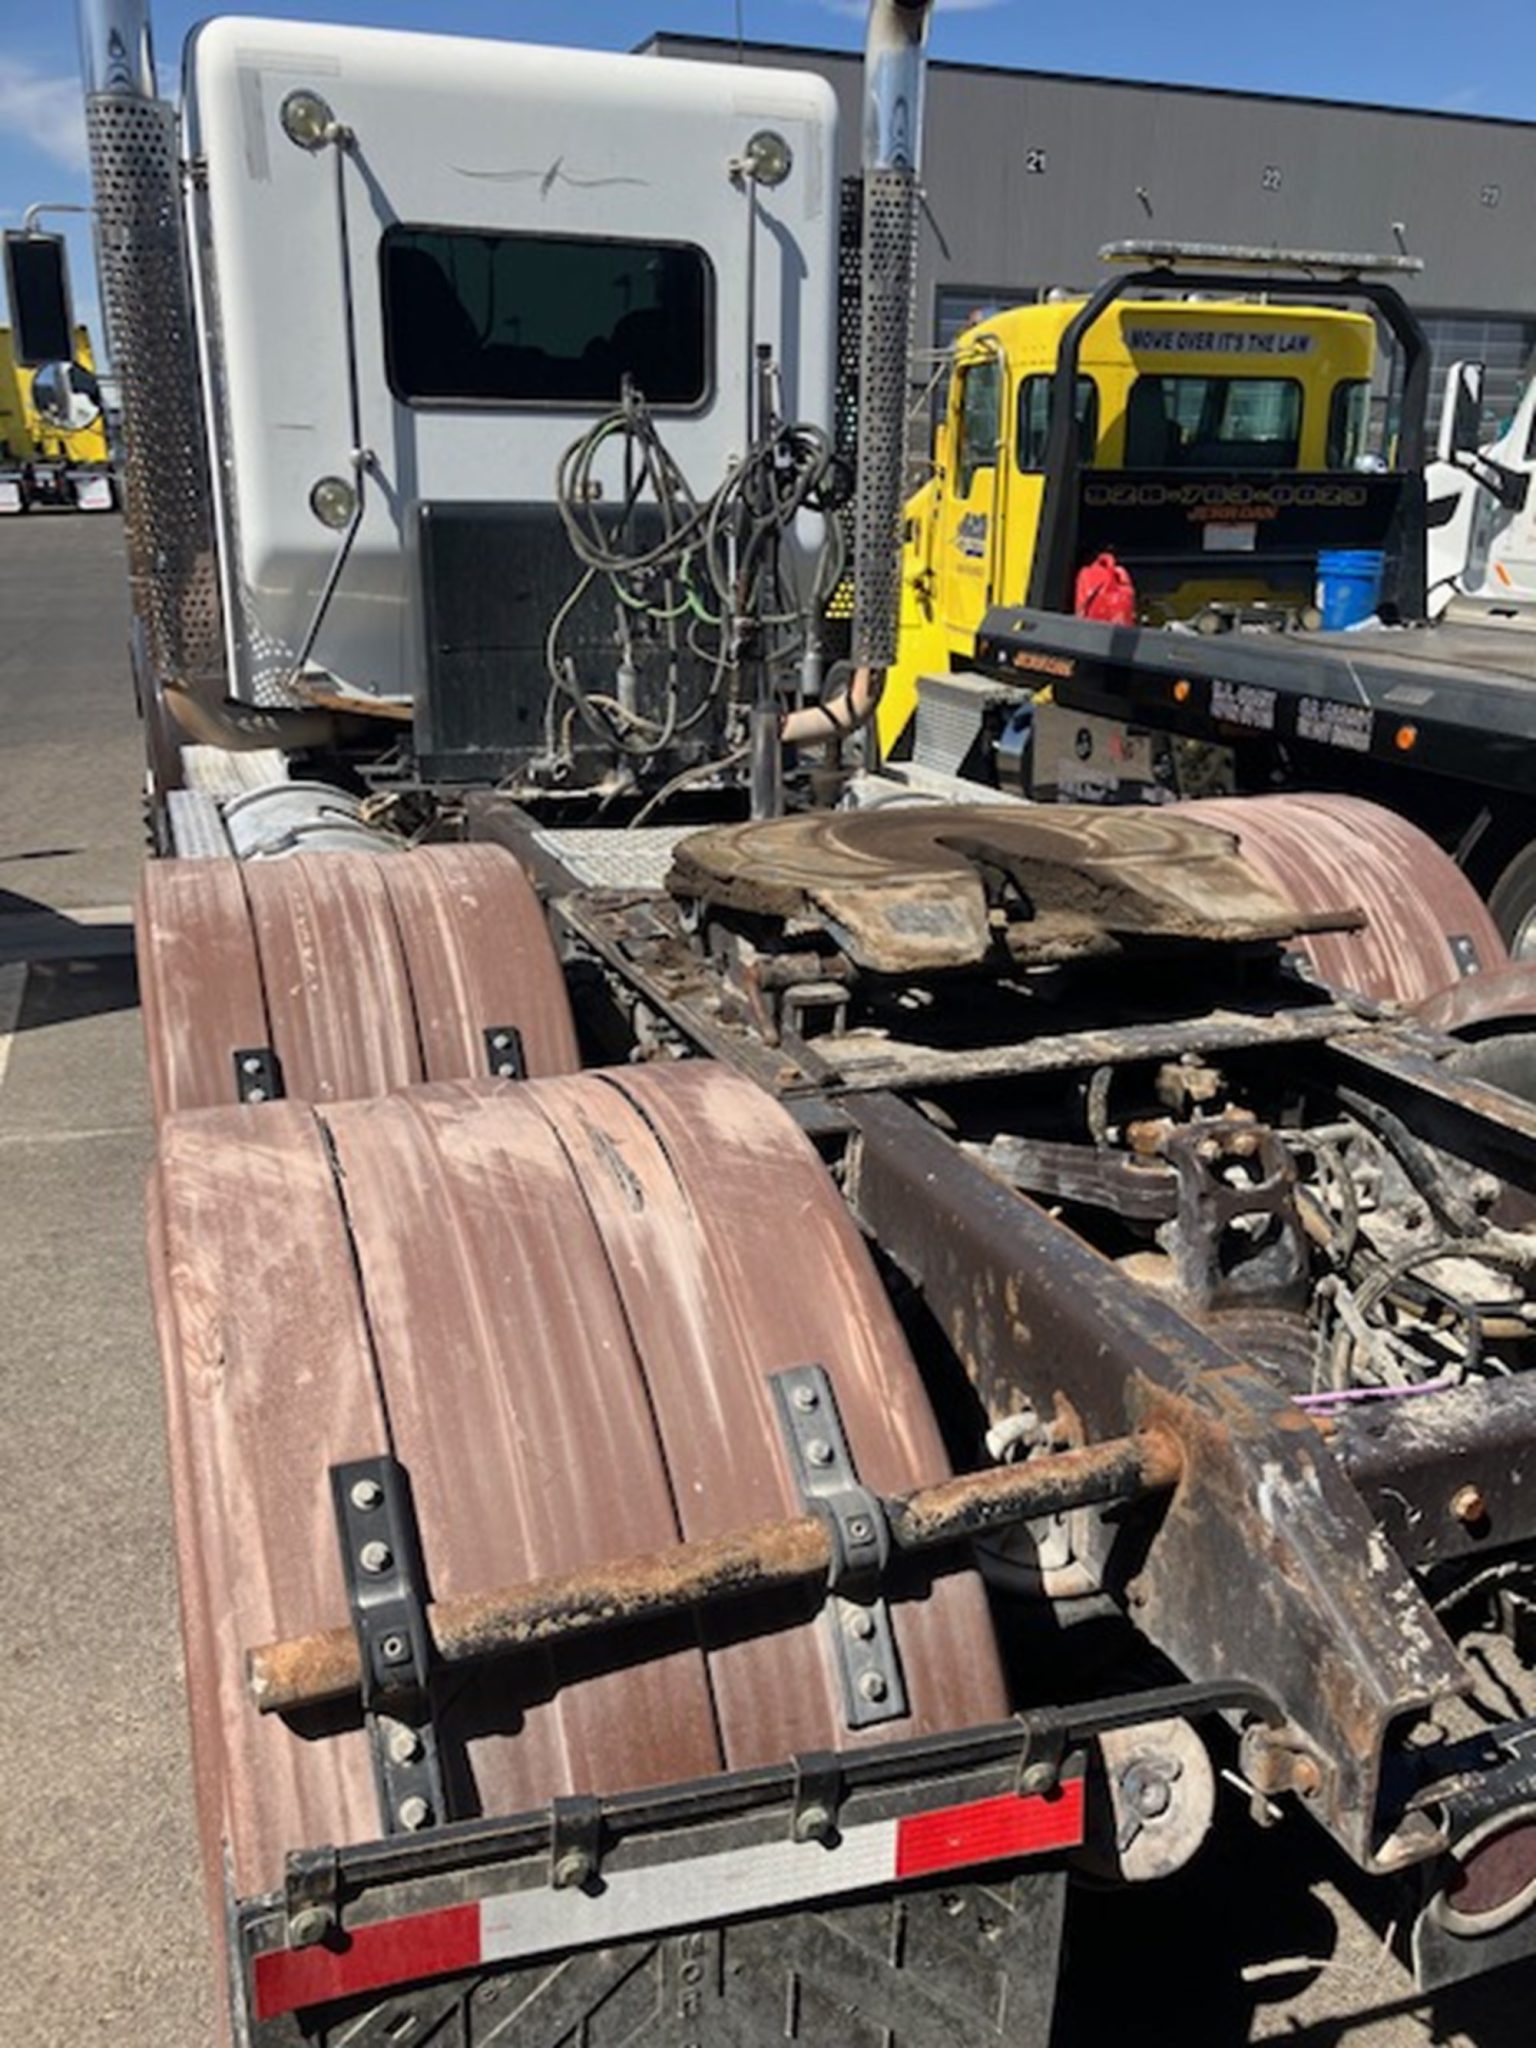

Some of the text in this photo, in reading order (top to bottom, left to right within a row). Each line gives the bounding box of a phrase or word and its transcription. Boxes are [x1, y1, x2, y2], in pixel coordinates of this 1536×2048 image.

[1027, 150, 1046, 171] 21
[1262, 168, 1281, 189] 22
[1131, 329, 1312, 353] MOVE OVER IT'S THE LAW
